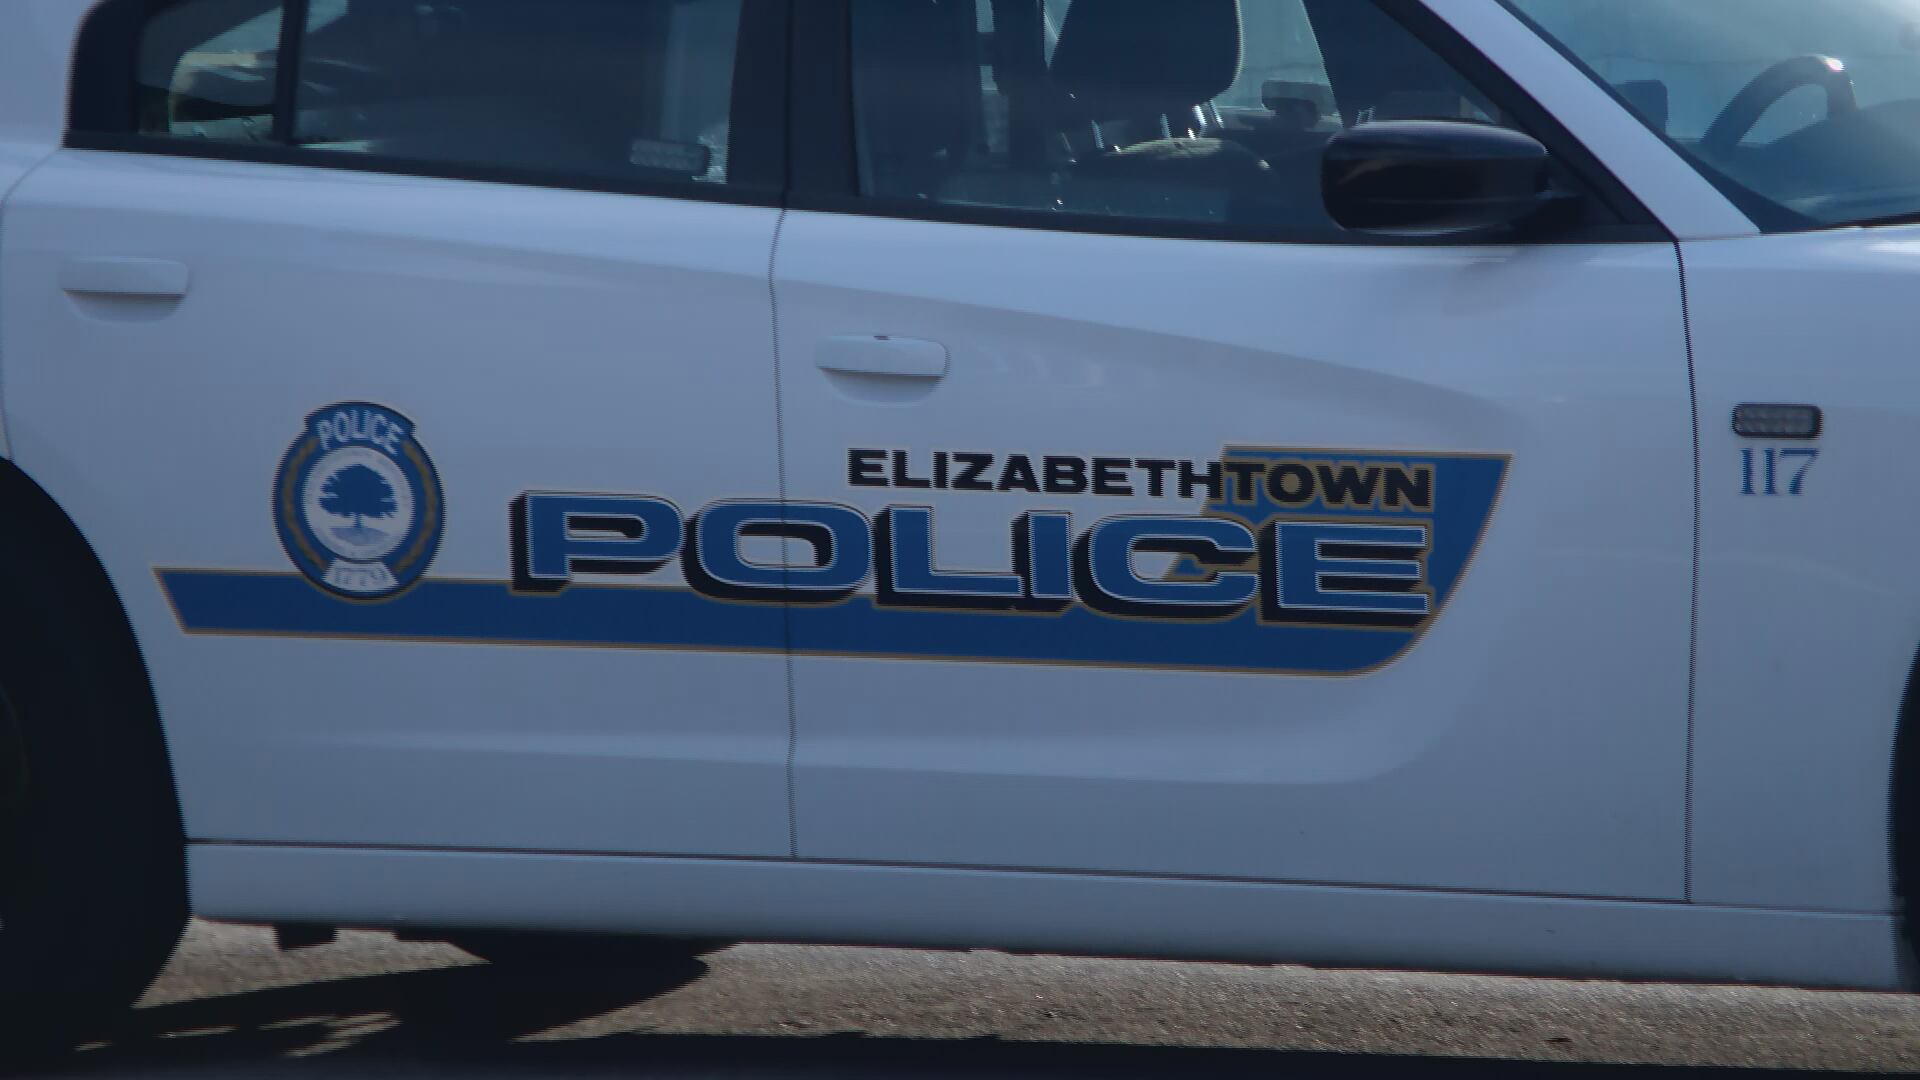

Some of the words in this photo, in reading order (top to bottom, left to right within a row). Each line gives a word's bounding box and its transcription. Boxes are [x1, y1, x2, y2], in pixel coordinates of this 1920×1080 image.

[316, 408, 404, 456] POLICE
[848, 449, 1433, 509] ELIZABETHTOWN
[1739, 448, 1820, 496] 117
[510, 491, 1431, 625] POLICE
